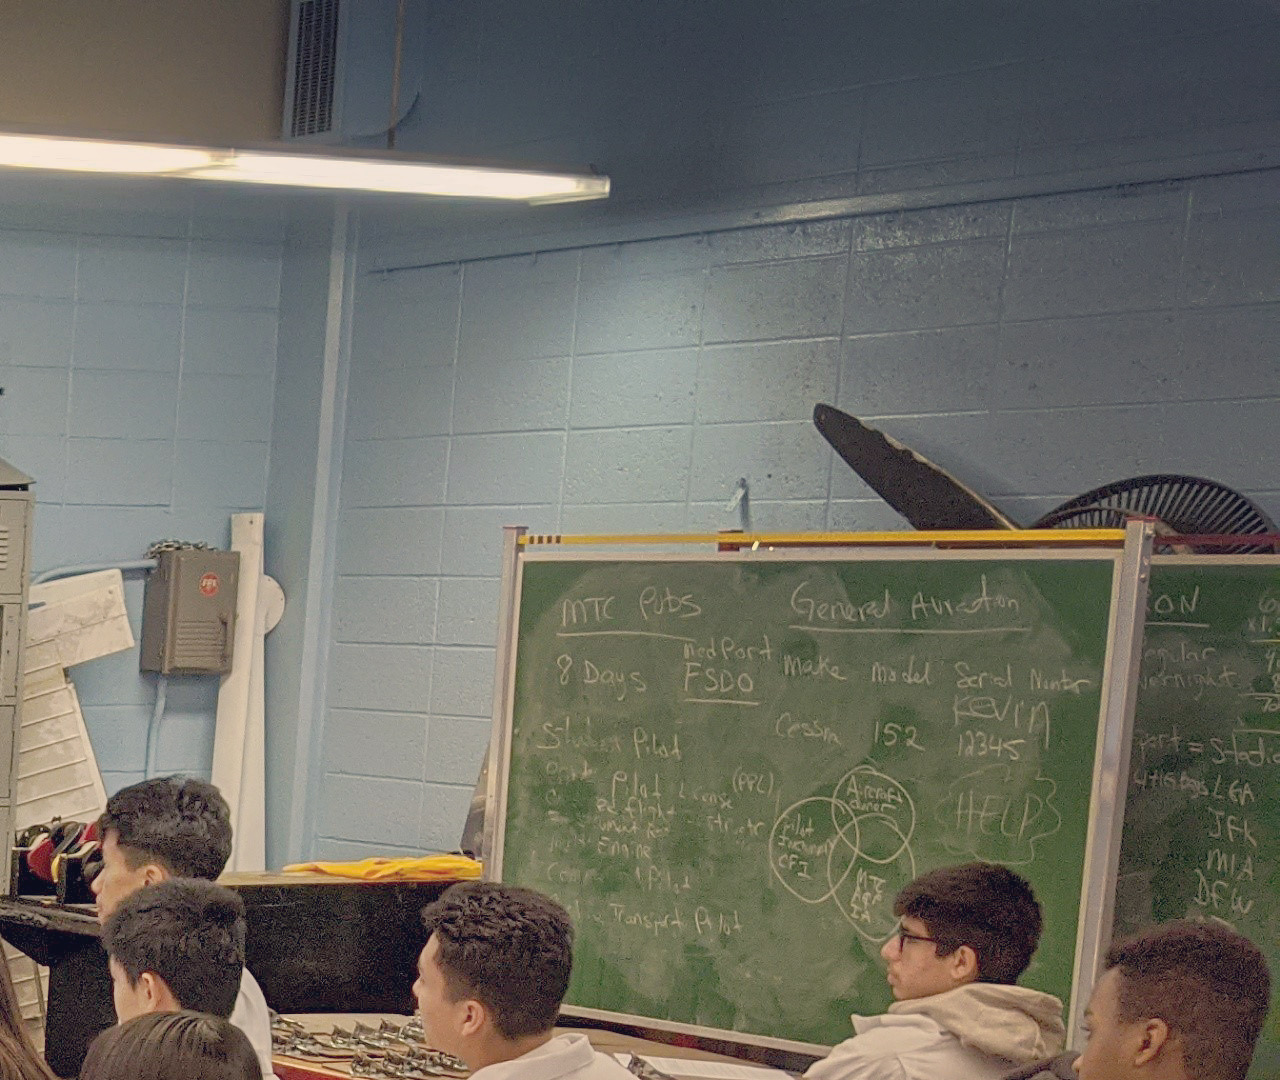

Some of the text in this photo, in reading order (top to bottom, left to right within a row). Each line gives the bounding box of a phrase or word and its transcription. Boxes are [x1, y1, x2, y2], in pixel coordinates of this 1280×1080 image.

[791, 581, 890, 623] General
[557, 654, 754, 701] 8 Days FSDO
[784, 655, 846, 680] Make
[872, 655, 931, 685] Model
[955, 662, 1012, 689] Serial
[874, 721, 926, 753] 152
[958, 729, 1027, 762] 12345
[955, 789, 1044, 846] HELP
